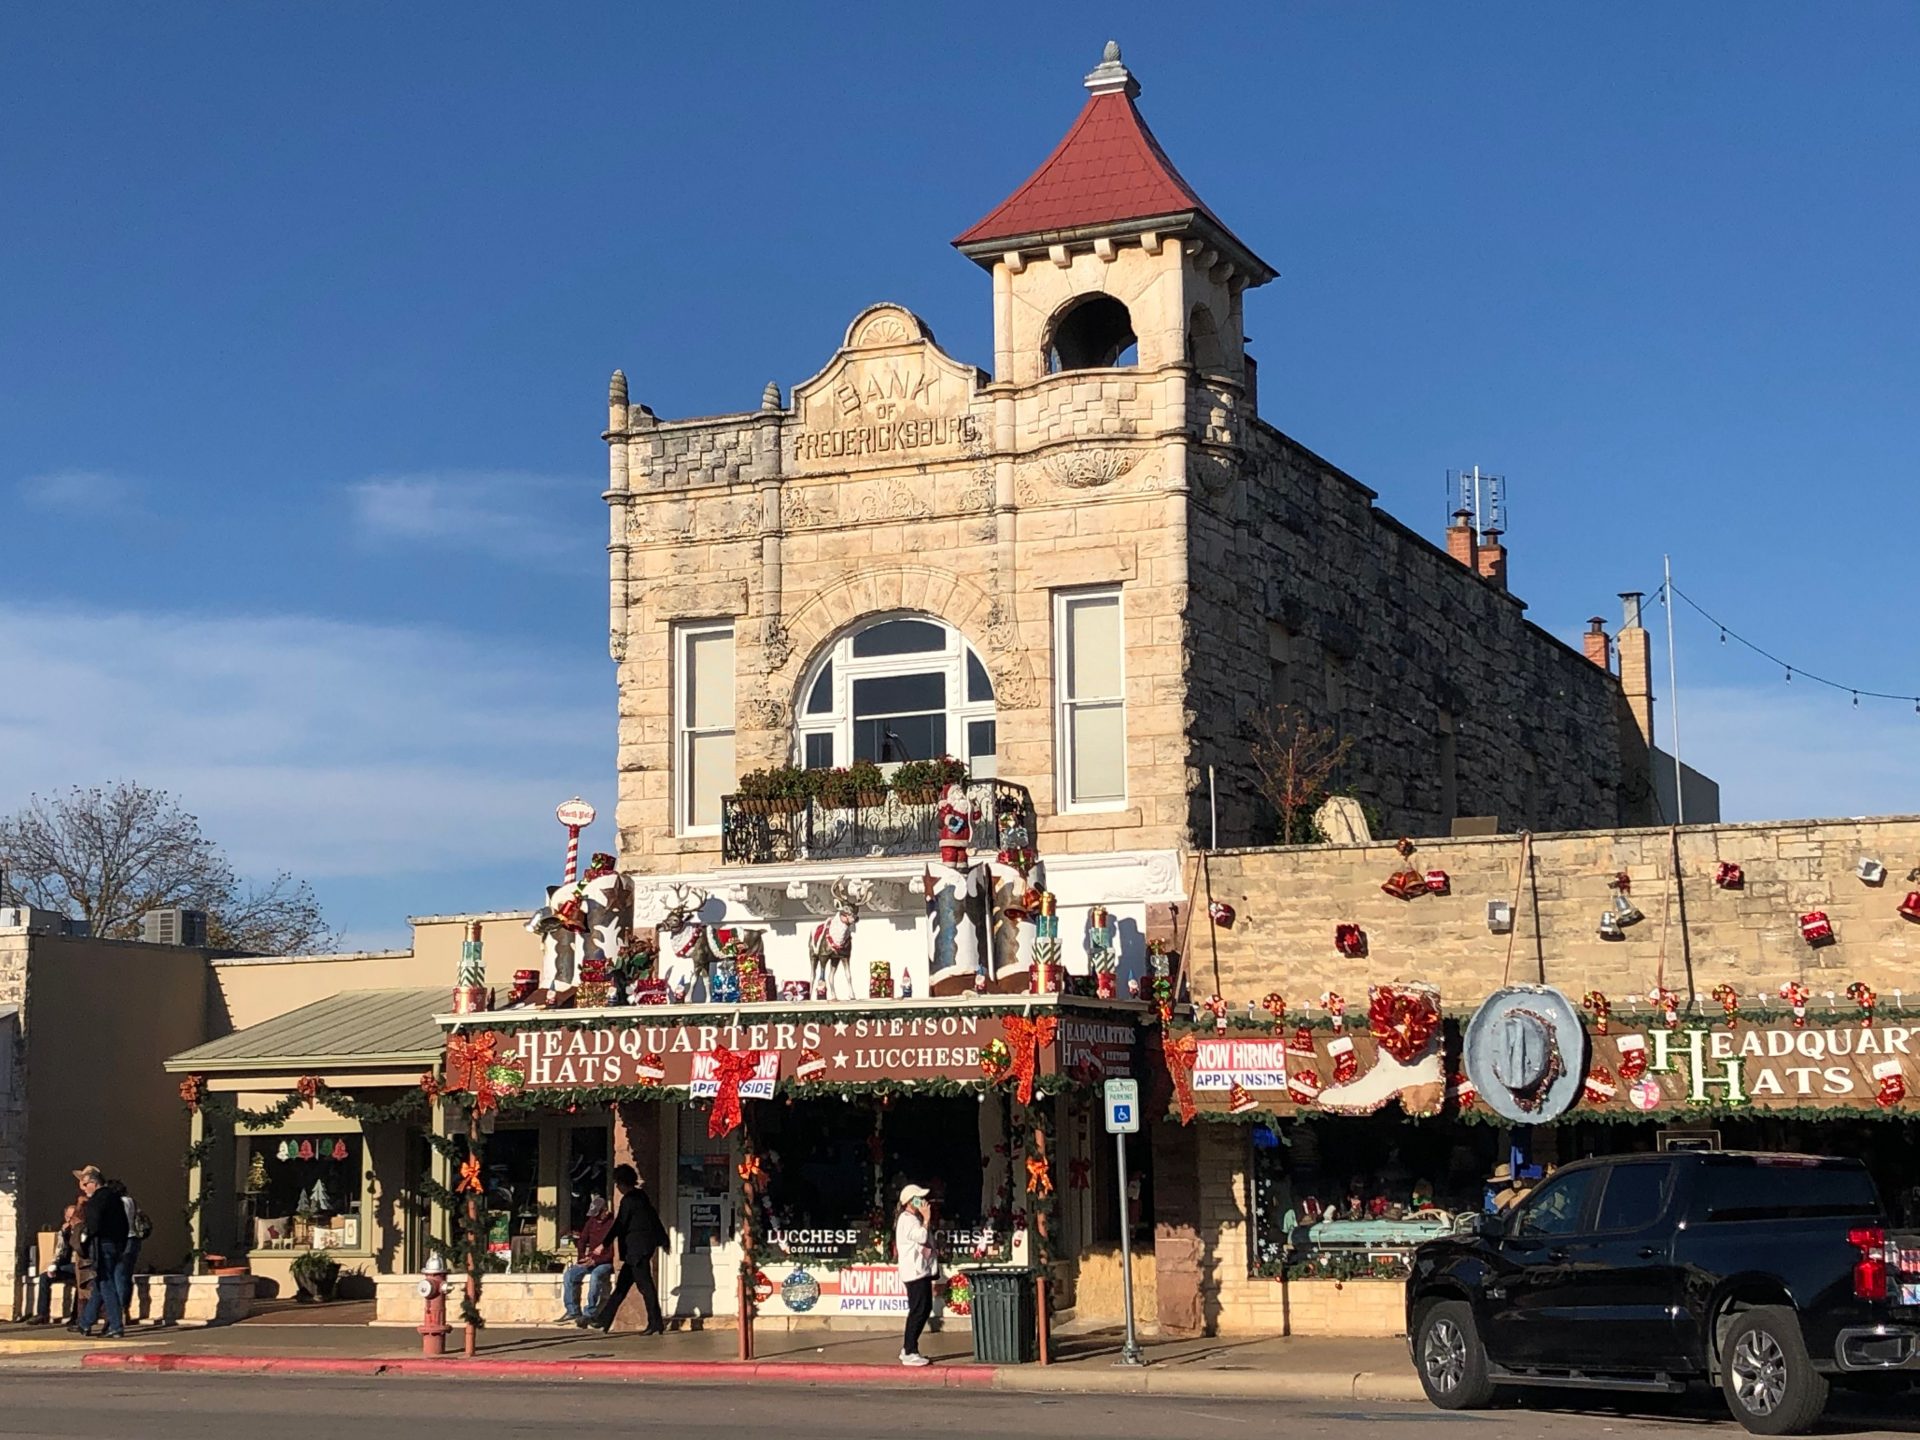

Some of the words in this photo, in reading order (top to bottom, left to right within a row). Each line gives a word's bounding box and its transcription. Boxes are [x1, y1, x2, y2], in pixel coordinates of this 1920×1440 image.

[833, 368, 938, 416] BANK
[875, 403, 896, 421] OF
[793, 415, 980, 461] FREDERICKSBURG
[855, 1016, 978, 1038] STETSON
[1057, 1019, 1137, 1046] HEADQUARTERS
[516, 1023, 821, 1060] HEADQUARTERS
[855, 1047, 980, 1068] LUCCHESE
[1196, 1043, 1231, 1069] NOW
[1232, 1043, 1285, 1069] HIRING
[527, 1056, 622, 1085] HATS
[1196, 1073, 1237, 1087] APPLY
[1240, 1073, 1285, 1086] INSIDE
[1688, 1060, 1855, 1101] HATS
[693, 1082, 718, 1094] APPL
[767, 1229, 857, 1244] LUCCHESE
[785, 1246, 839, 1254] OOTMAKER
[841, 1270, 871, 1295] NOW
[840, 1299, 875, 1311] APPLY
[879, 1299, 909, 1311] INSID
